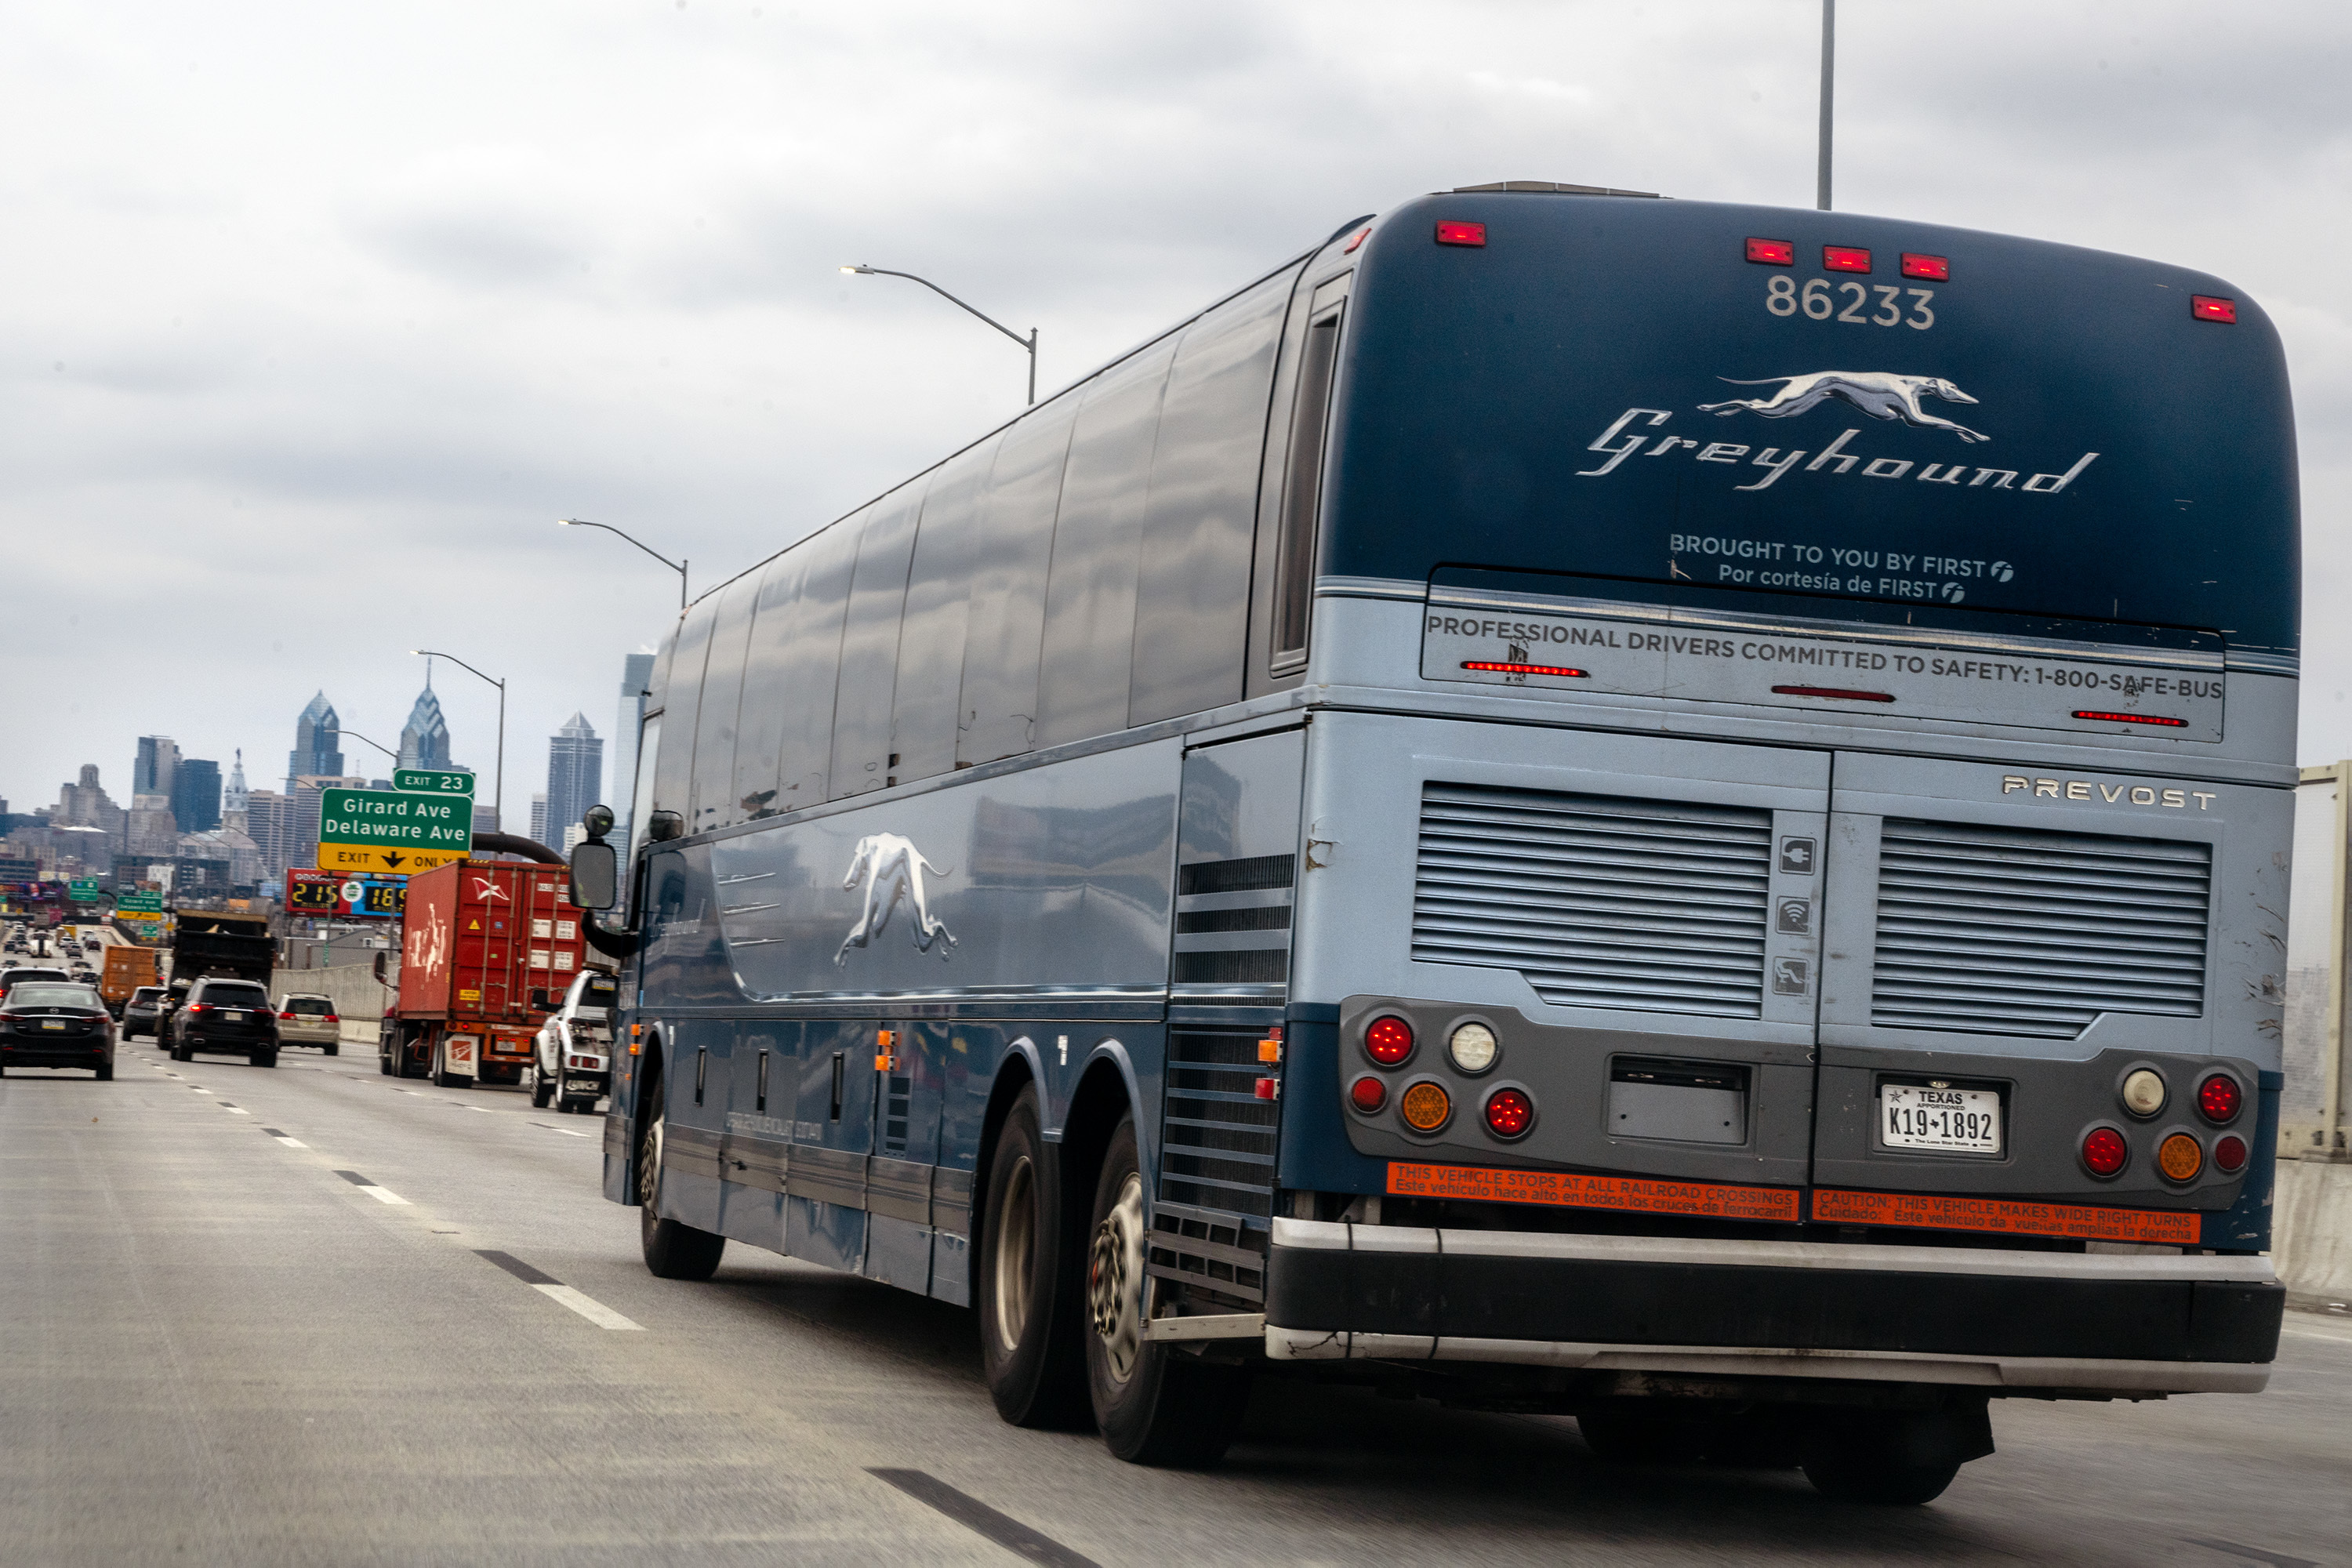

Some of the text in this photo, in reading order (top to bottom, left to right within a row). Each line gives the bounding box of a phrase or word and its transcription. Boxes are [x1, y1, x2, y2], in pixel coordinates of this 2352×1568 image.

[1766, 275, 1935, 330] 86233
[1576, 408, 2100, 495] Greyhound
[1671, 534, 1987, 578] BROUGHT TO YOU BY FIRST
[1719, 564, 1936, 599] Por cortesía de FIRST
[1428, 615, 2223, 699] PROFESSIONAL DRIVERS COMMITTED TO SAFETY: 1-800-SAFE-BUS
[405, 775, 463, 790] EXIT 23
[2002, 775, 2217, 811] PREVOST
[343, 798, 451, 818] Girard Ave
[325, 818, 466, 841] Delaware Ave
[338, 851, 370, 863] EXIT
[1916, 1102, 1965, 1111] APPORTIONED
[1918, 1091, 1963, 1105] TEXAS
[1396, 1165, 1793, 1206] THIS VEHICLE STOPS AT ALL RAILROAD CROSSINGS
[1396, 1178, 1426, 1192] Este
[1494, 1185, 1527, 1200] hace
[1531, 1188, 1559, 1201] alto
[1563, 1192, 1580, 1204] en
[1584, 1192, 1624, 1207] todos
[1628, 1195, 1650, 1208] los
[1653, 1199, 1699, 1212] cruces
[1701, 1201, 1719, 1213] de
[1723, 1202, 1792, 1218] ferrocarril
[1819, 1205, 1882, 1221] Cuidado:
[1894, 1210, 1922, 1223] Este
[1990, 1216, 2006, 1228] da
[2067, 1221, 2120, 1237] amplias
[2124, 1225, 2136, 1237] la
[2140, 1225, 2192, 1240] derecha
[1820, 1192, 2190, 1228] CAUTION: THIS VEHICLE MAKES WIDE RIGHT TURNS
